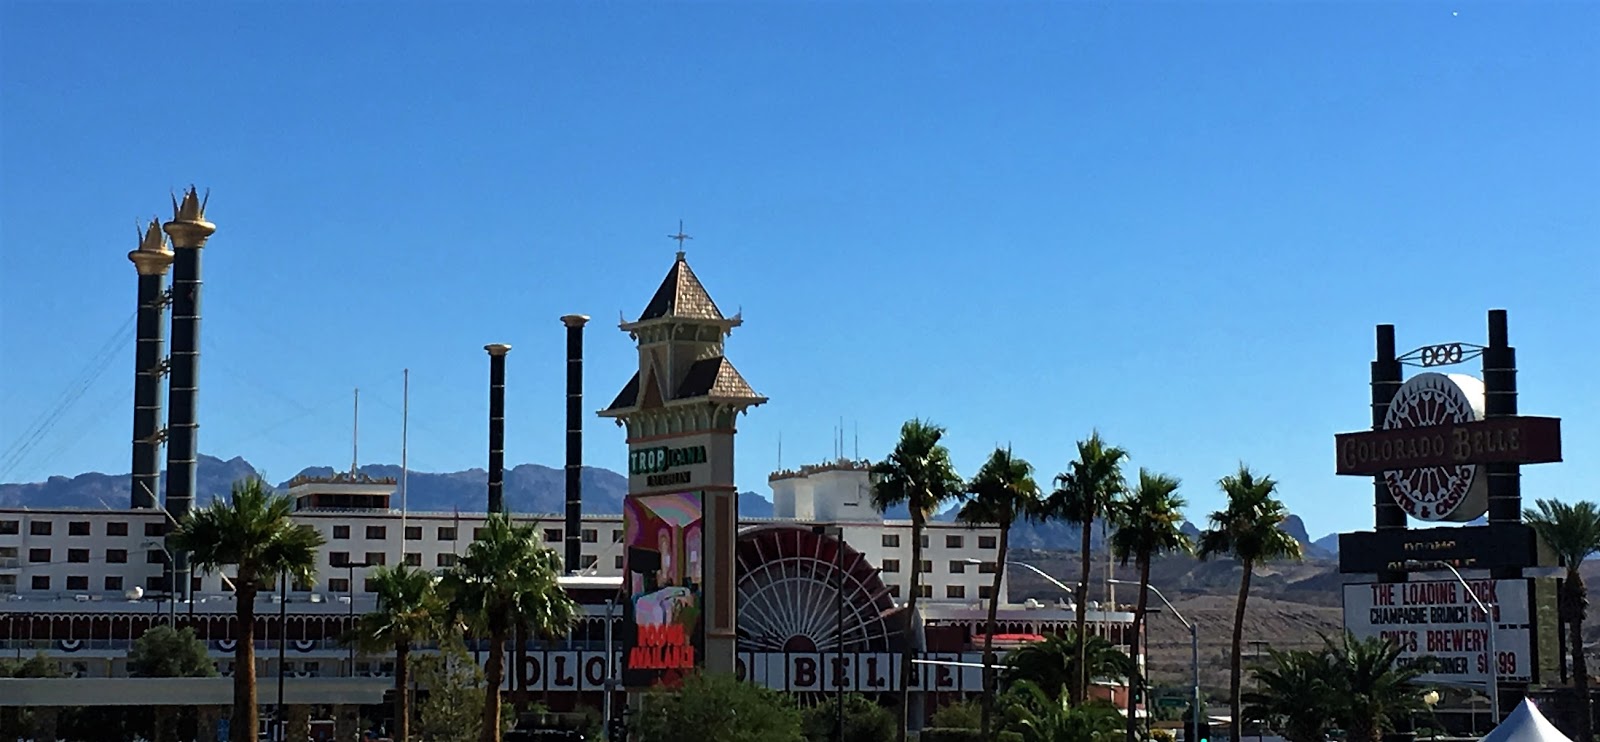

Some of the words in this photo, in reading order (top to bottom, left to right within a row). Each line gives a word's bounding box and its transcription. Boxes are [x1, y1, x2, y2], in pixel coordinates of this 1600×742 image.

[1342, 434, 1445, 469] COLORADO
[1452, 427, 1520, 460] BELLE
[1435, 467, 1471, 516] CASINO
[1371, 584, 1395, 606] THE
[1402, 581, 1456, 605] LOADING
[1464, 580, 1498, 603] DOCK
[1430, 606, 1468, 623] BRUNCH
[638, 623, 684, 646] ROOMS
[1427, 629, 1489, 651] BREWERY
